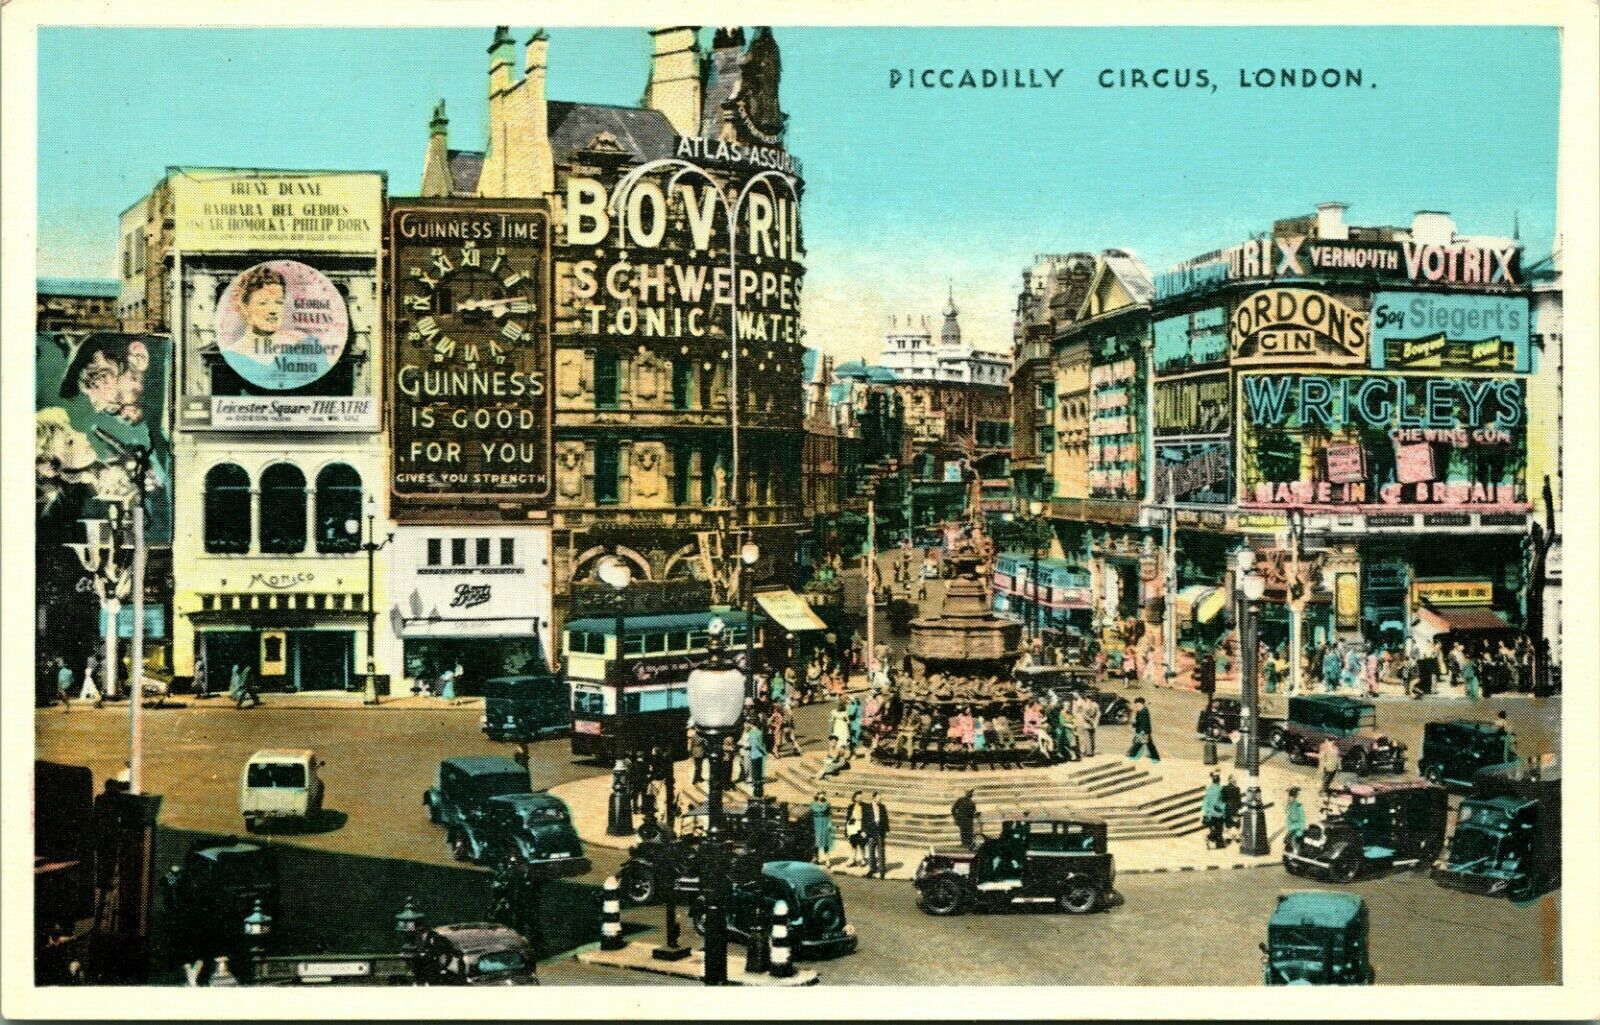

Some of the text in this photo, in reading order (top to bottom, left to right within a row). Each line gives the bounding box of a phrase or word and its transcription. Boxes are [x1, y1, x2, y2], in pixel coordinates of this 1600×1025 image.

[677, 136, 742, 162] ATLAS
[231, 182, 322, 196] IRENE DUNNE
[203, 203, 349, 217] BARBARA BEL GEDDES
[567, 177, 804, 262] BOVRIL
[337, 218, 371, 232] DORN
[1310, 245, 1399, 270] VERMOUTH
[1402, 240, 1518, 288] VOTRIX
[574, 260, 803, 311] SCHWEPPES
[293, 299, 330, 310] GEORGE
[585, 304, 705, 337] TONIC
[1231, 291, 1365, 351] GORDON'S
[1375, 297, 1520, 337] Say Siegert's
[254, 338, 339, 355] I Remember
[1261, 332, 1311, 350] GIN
[274, 356, 318, 373] Mama
[216, 399, 370, 417] Leicester Square THEATRE
[411, 407, 535, 430] IS GOOD
[410, 441, 534, 464] FOR YOU
[396, 472, 546, 484] GIVES YOU STRENGTH
